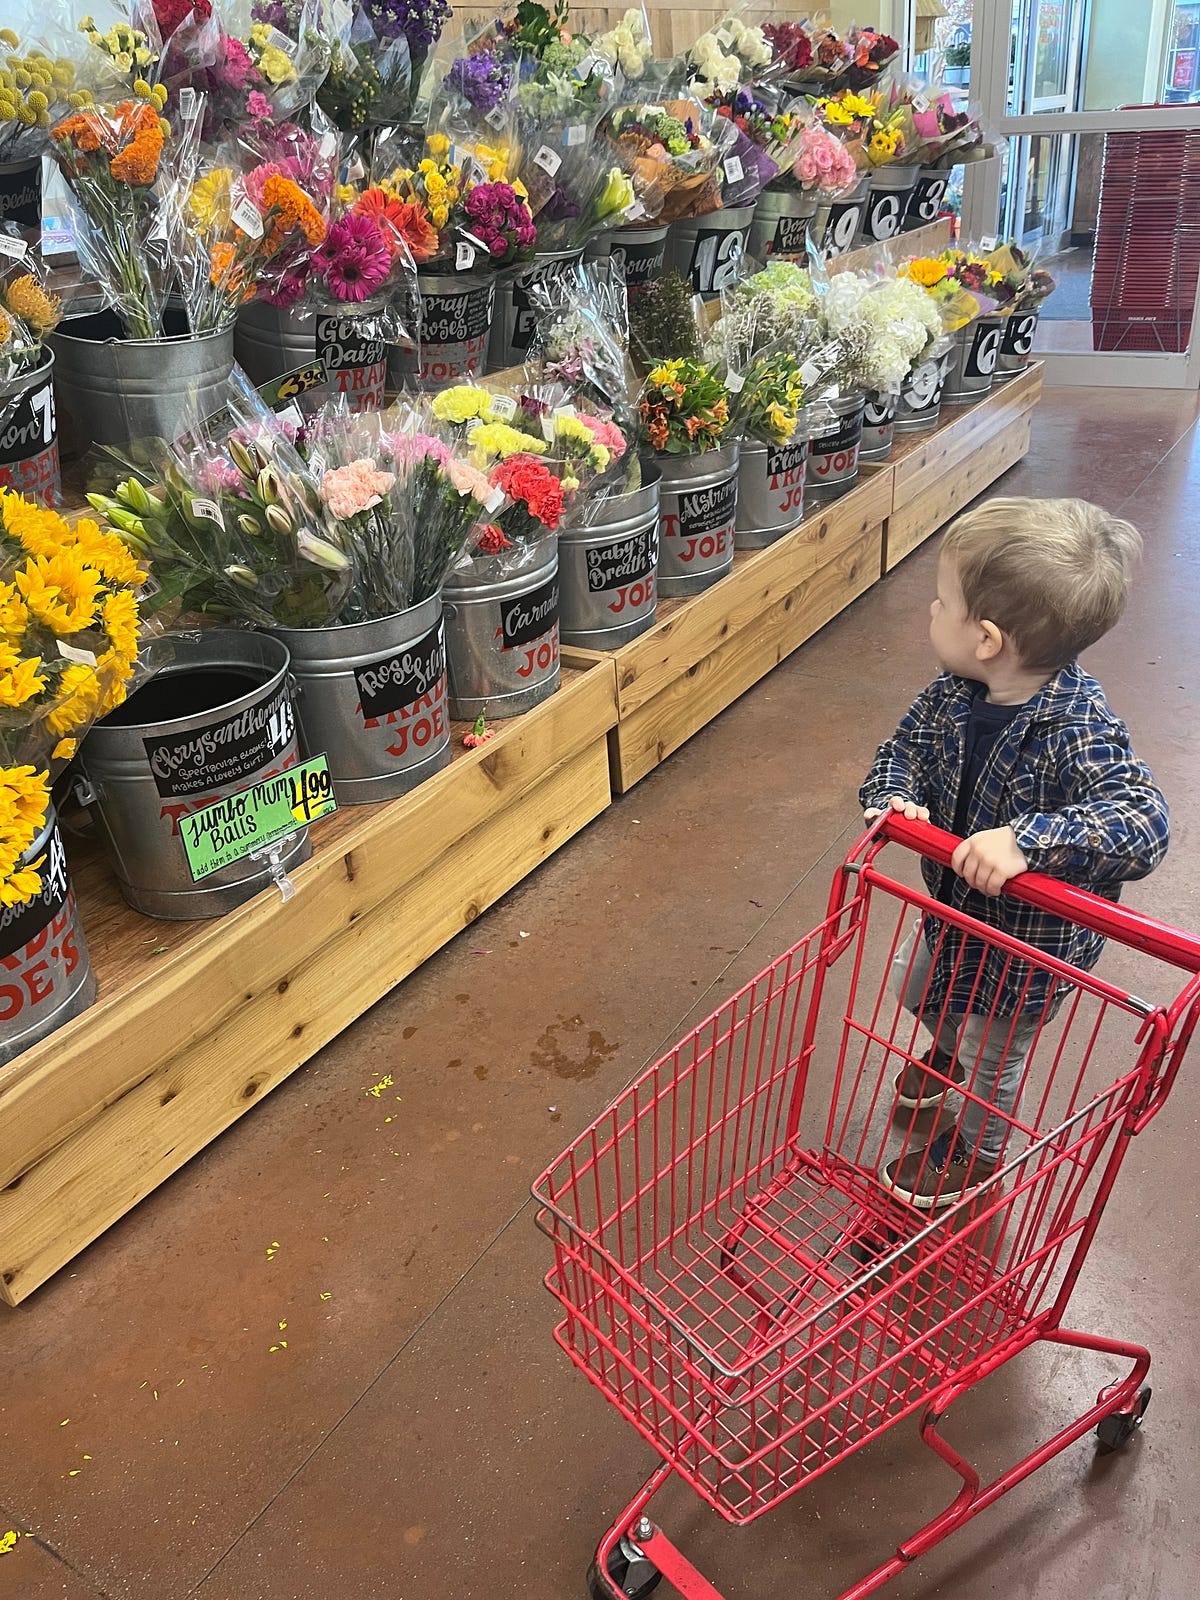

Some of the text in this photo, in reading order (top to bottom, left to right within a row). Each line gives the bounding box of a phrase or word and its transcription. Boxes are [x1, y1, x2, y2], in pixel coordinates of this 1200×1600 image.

[321, 340, 385, 369] Daisy
[587, 531, 648, 568] Baby's
[589, 552, 647, 590] Breath
[357, 653, 414, 698] Rose
[172, 779, 205, 794] Makes
[206, 775, 215, 786] A
[187, 794, 250, 848] Jumbo
[209, 814, 258, 853] Balls
[196, 860, 210, 876] add
[210, 855, 227, 873] them
[225, 850, 234, 862] to
